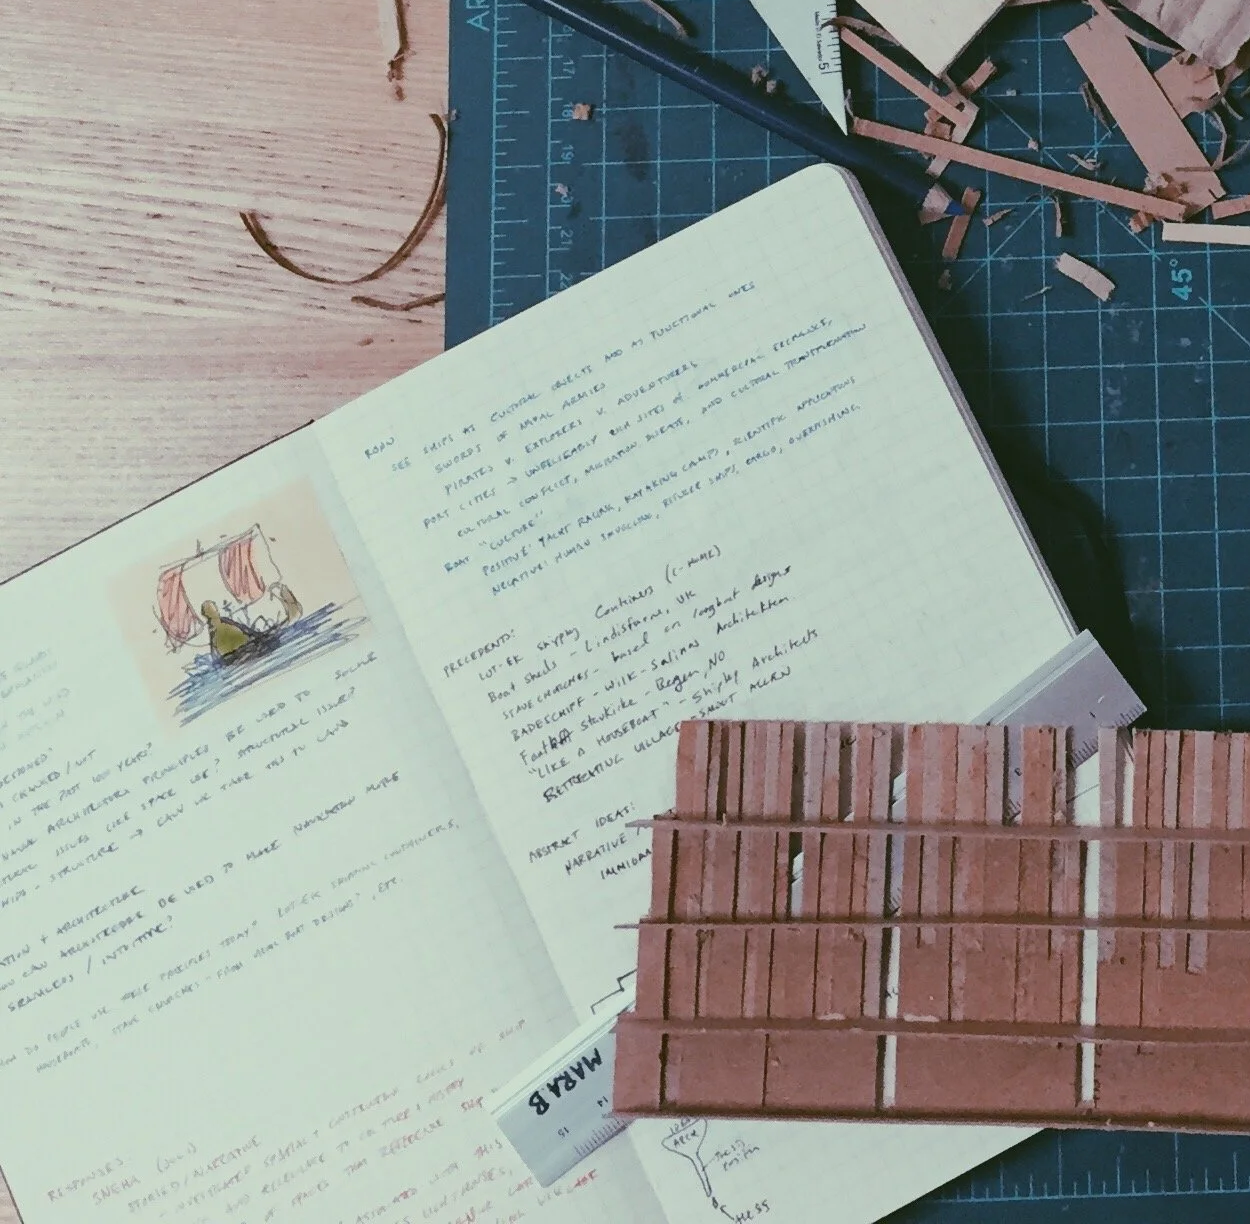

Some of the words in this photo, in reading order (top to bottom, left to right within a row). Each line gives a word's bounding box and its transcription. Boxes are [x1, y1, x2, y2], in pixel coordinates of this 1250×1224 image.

[1169, 258, 1193, 300] 45°
[547, 1048, 604, 1098] MARA
[528, 1089, 551, 1117] B
